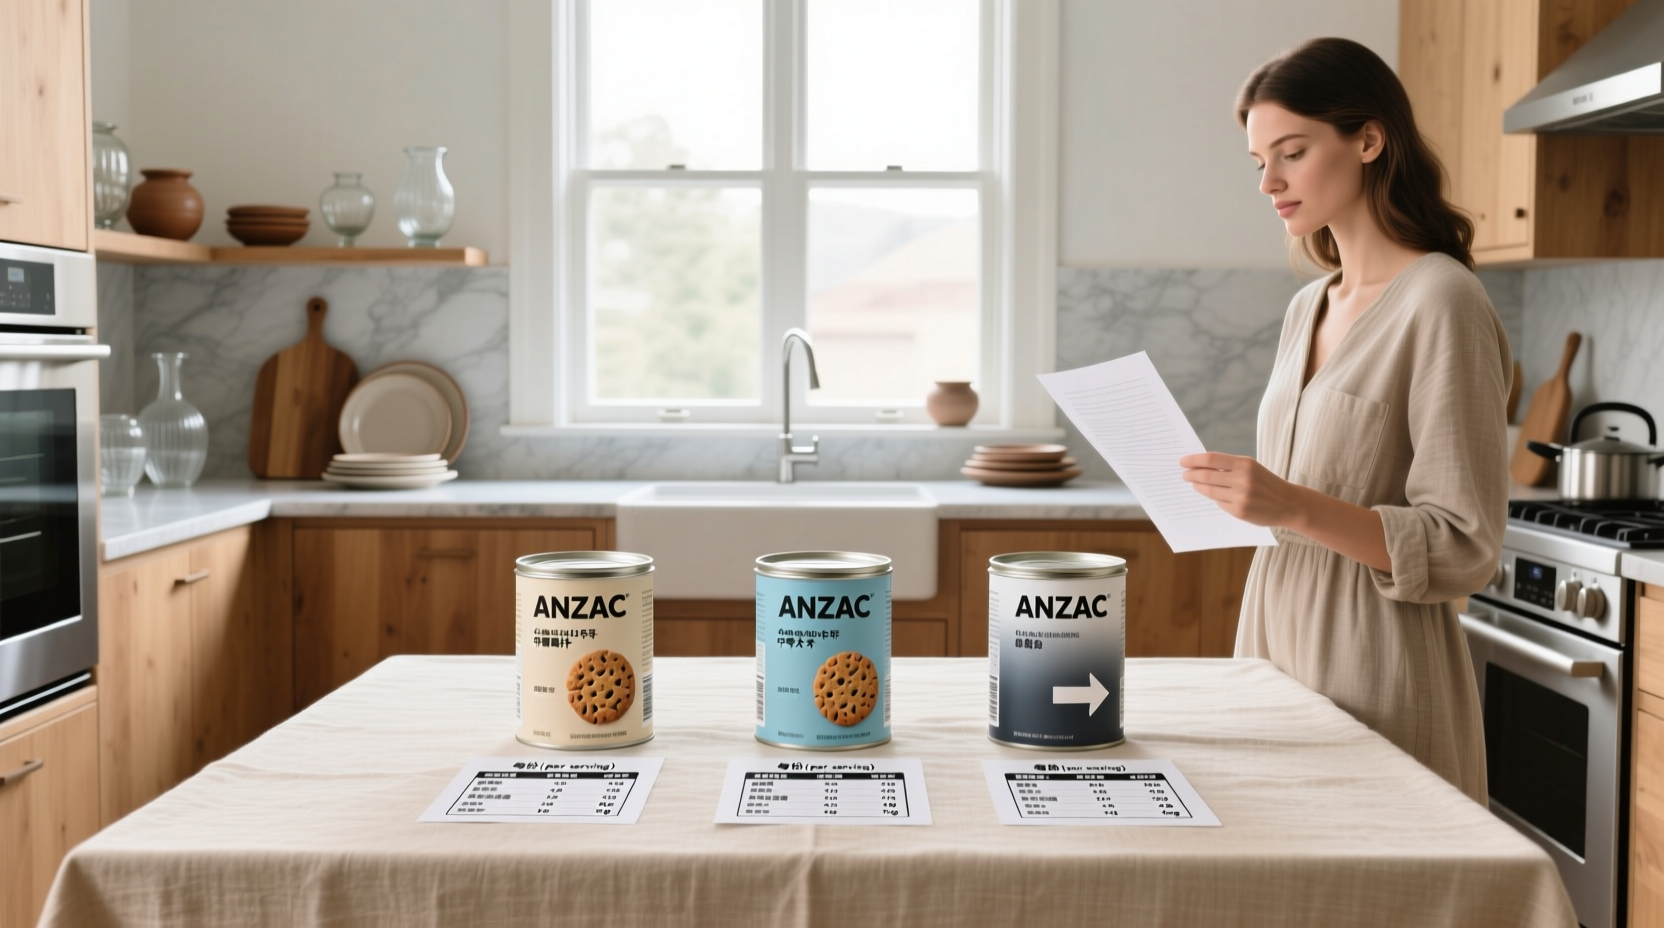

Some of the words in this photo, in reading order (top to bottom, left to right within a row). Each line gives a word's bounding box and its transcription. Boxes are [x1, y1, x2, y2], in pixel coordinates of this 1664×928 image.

[534, 595, 626, 619] ANZAC
[779, 595, 870, 619] ANZAC
[1016, 595, 1107, 619] ANZAC
